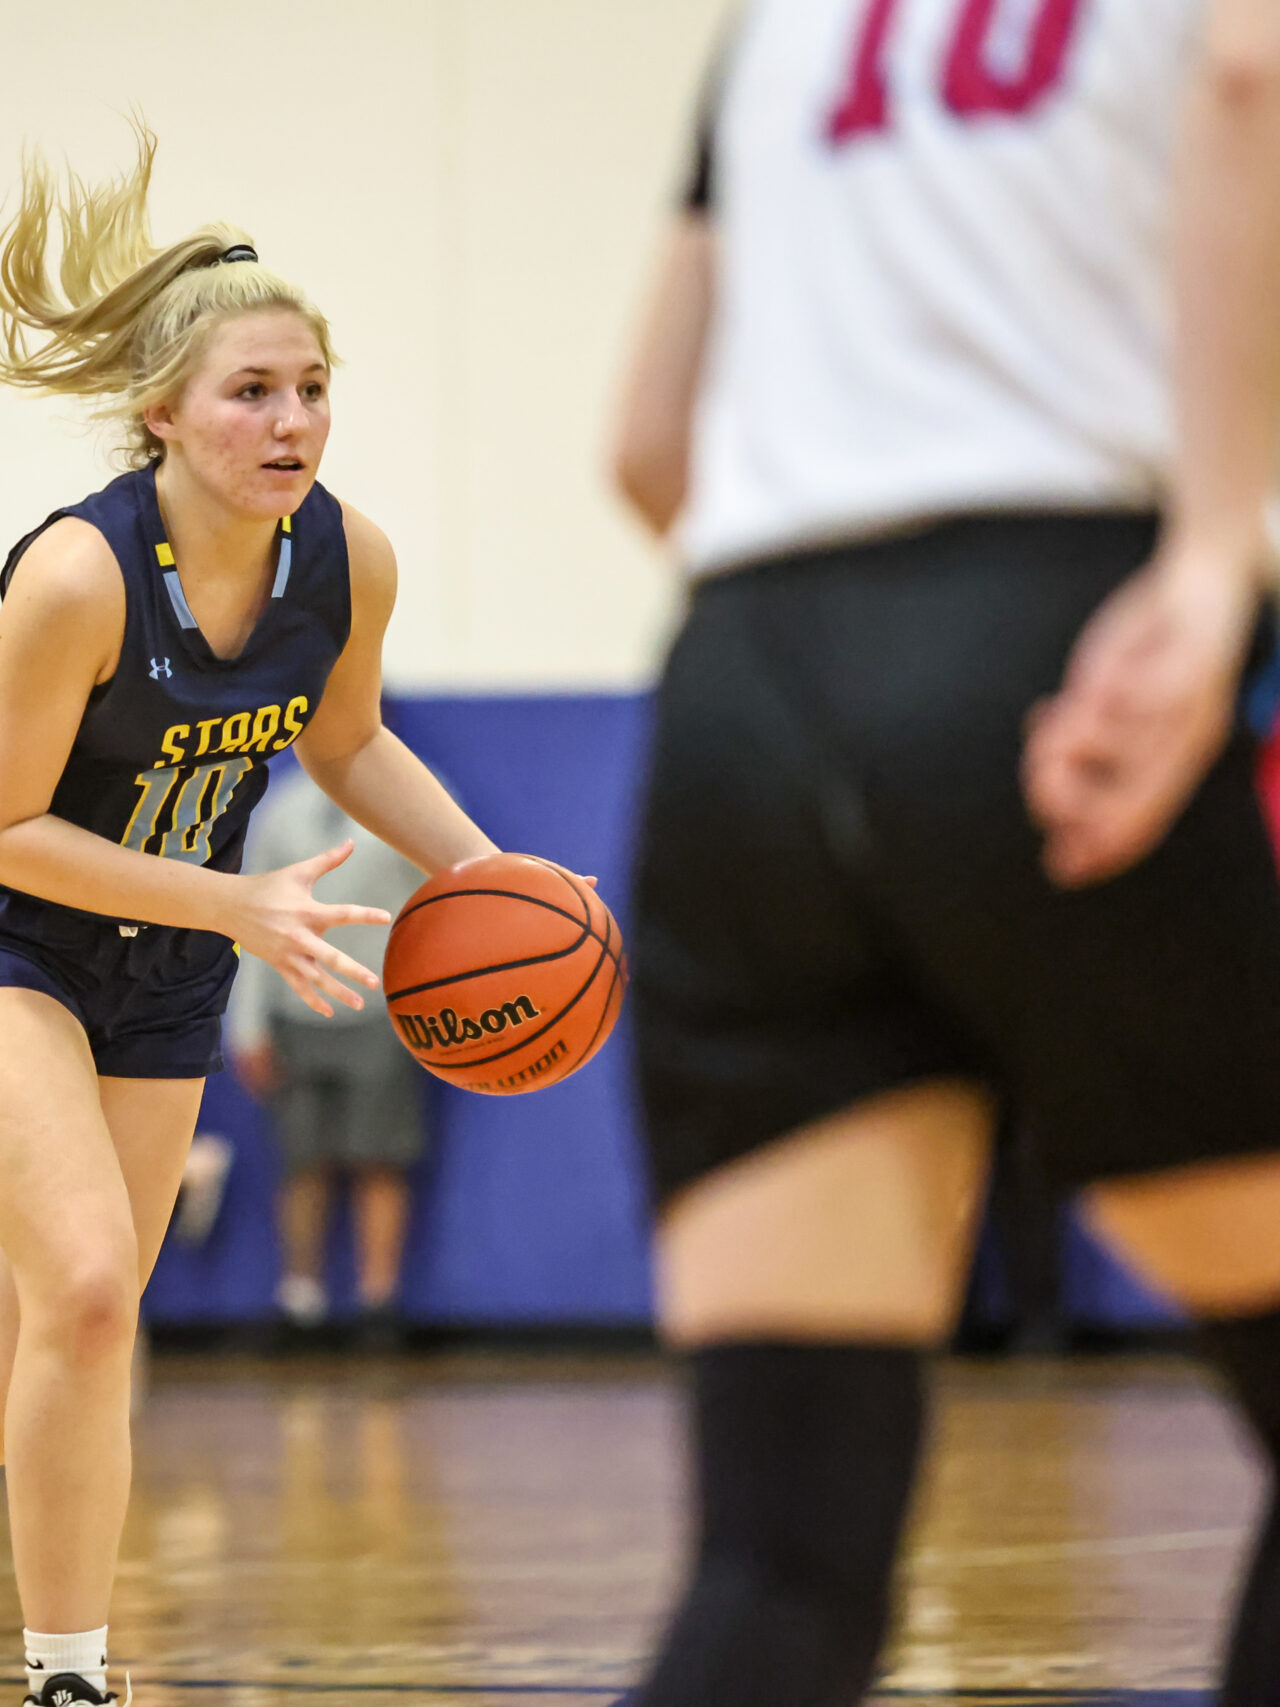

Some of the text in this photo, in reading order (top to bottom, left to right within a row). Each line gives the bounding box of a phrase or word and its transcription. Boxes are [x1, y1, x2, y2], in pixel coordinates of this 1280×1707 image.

[153, 695, 309, 770] STARS
[119, 756, 254, 867] 10
[395, 994, 541, 1051] Wilson
